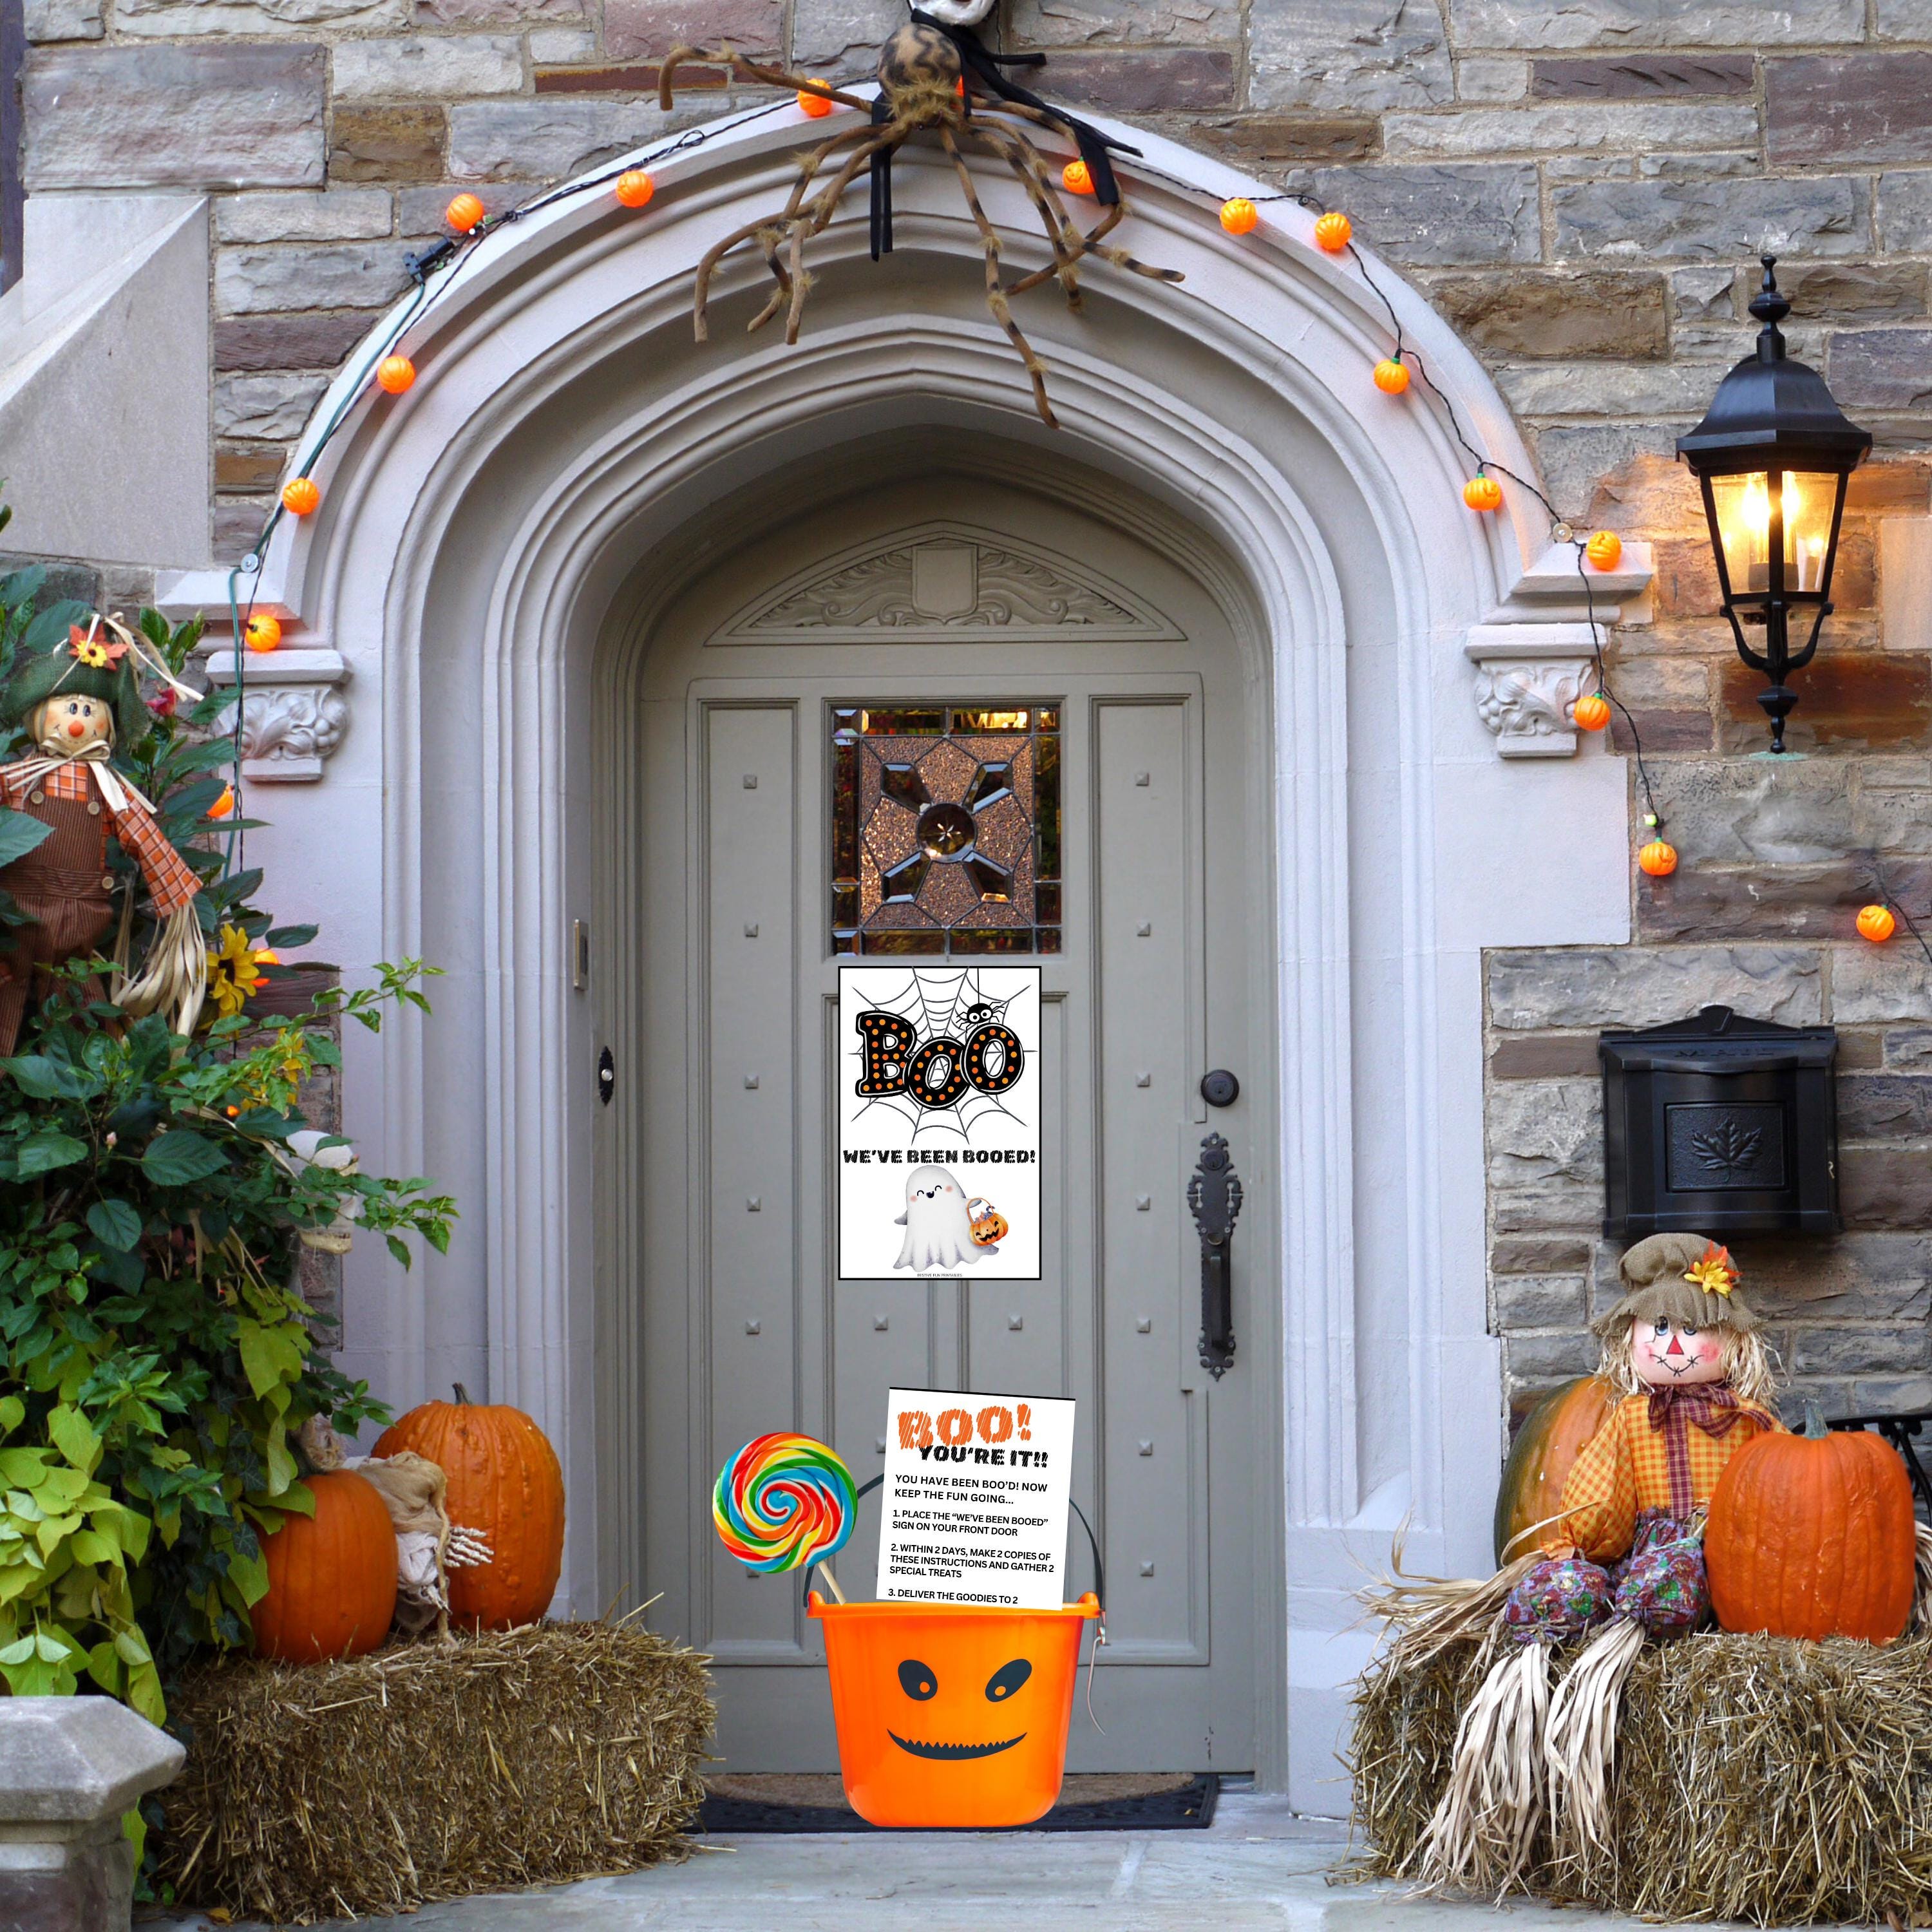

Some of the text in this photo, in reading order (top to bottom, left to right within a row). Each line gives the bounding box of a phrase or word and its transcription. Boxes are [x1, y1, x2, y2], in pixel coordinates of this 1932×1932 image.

[855, 1010, 1025, 1110] BOO
[843, 1150, 1036, 1163] WE'VE BEEN BOOED!
[898, 1404, 1031, 1450] BOO!
[919, 1445, 1048, 1468] YOU'RE IT!!
[895, 1474, 1048, 1492] YOU HAVE BEEN BOO'D! NOW
[895, 1489, 1014, 1504] KEEP THE FUN GOING...
[902, 1510, 931, 1519] PLACE
[952, 1513, 984, 1522] "WE'VE
[985, 1515, 1009, 1524] BEEN
[1012, 1517, 1048, 1526] BOOED"
[892, 1521, 914, 1530] SIGN
[932, 1524, 957, 1533] YOUR
[959, 1526, 989, 1534] FRONT
[991, 1528, 1018, 1536] DOOR
[900, 1544, 933, 1553] WITHIN
[942, 1547, 968, 1557] DAYS,
[970, 1549, 996, 1557] MAKE
[1004, 1551, 1037, 1560] COPIES
[1039, 1553, 1051, 1561] OF
[891, 1555, 919, 1564] THESE
[921, 1557, 987, 1567] INSTRUCTIONS
[989, 1561, 1009, 1569] AND
[1011, 1562, 1047, 1572] GATHER
[889, 1566, 962, 1578] SPECIAL TREATS
[898, 1589, 935, 1599] DELIVER
[937, 1591, 954, 1600] THE
[956, 1593, 997, 1602] GOODIES
[999, 1595, 1011, 1604] TO
